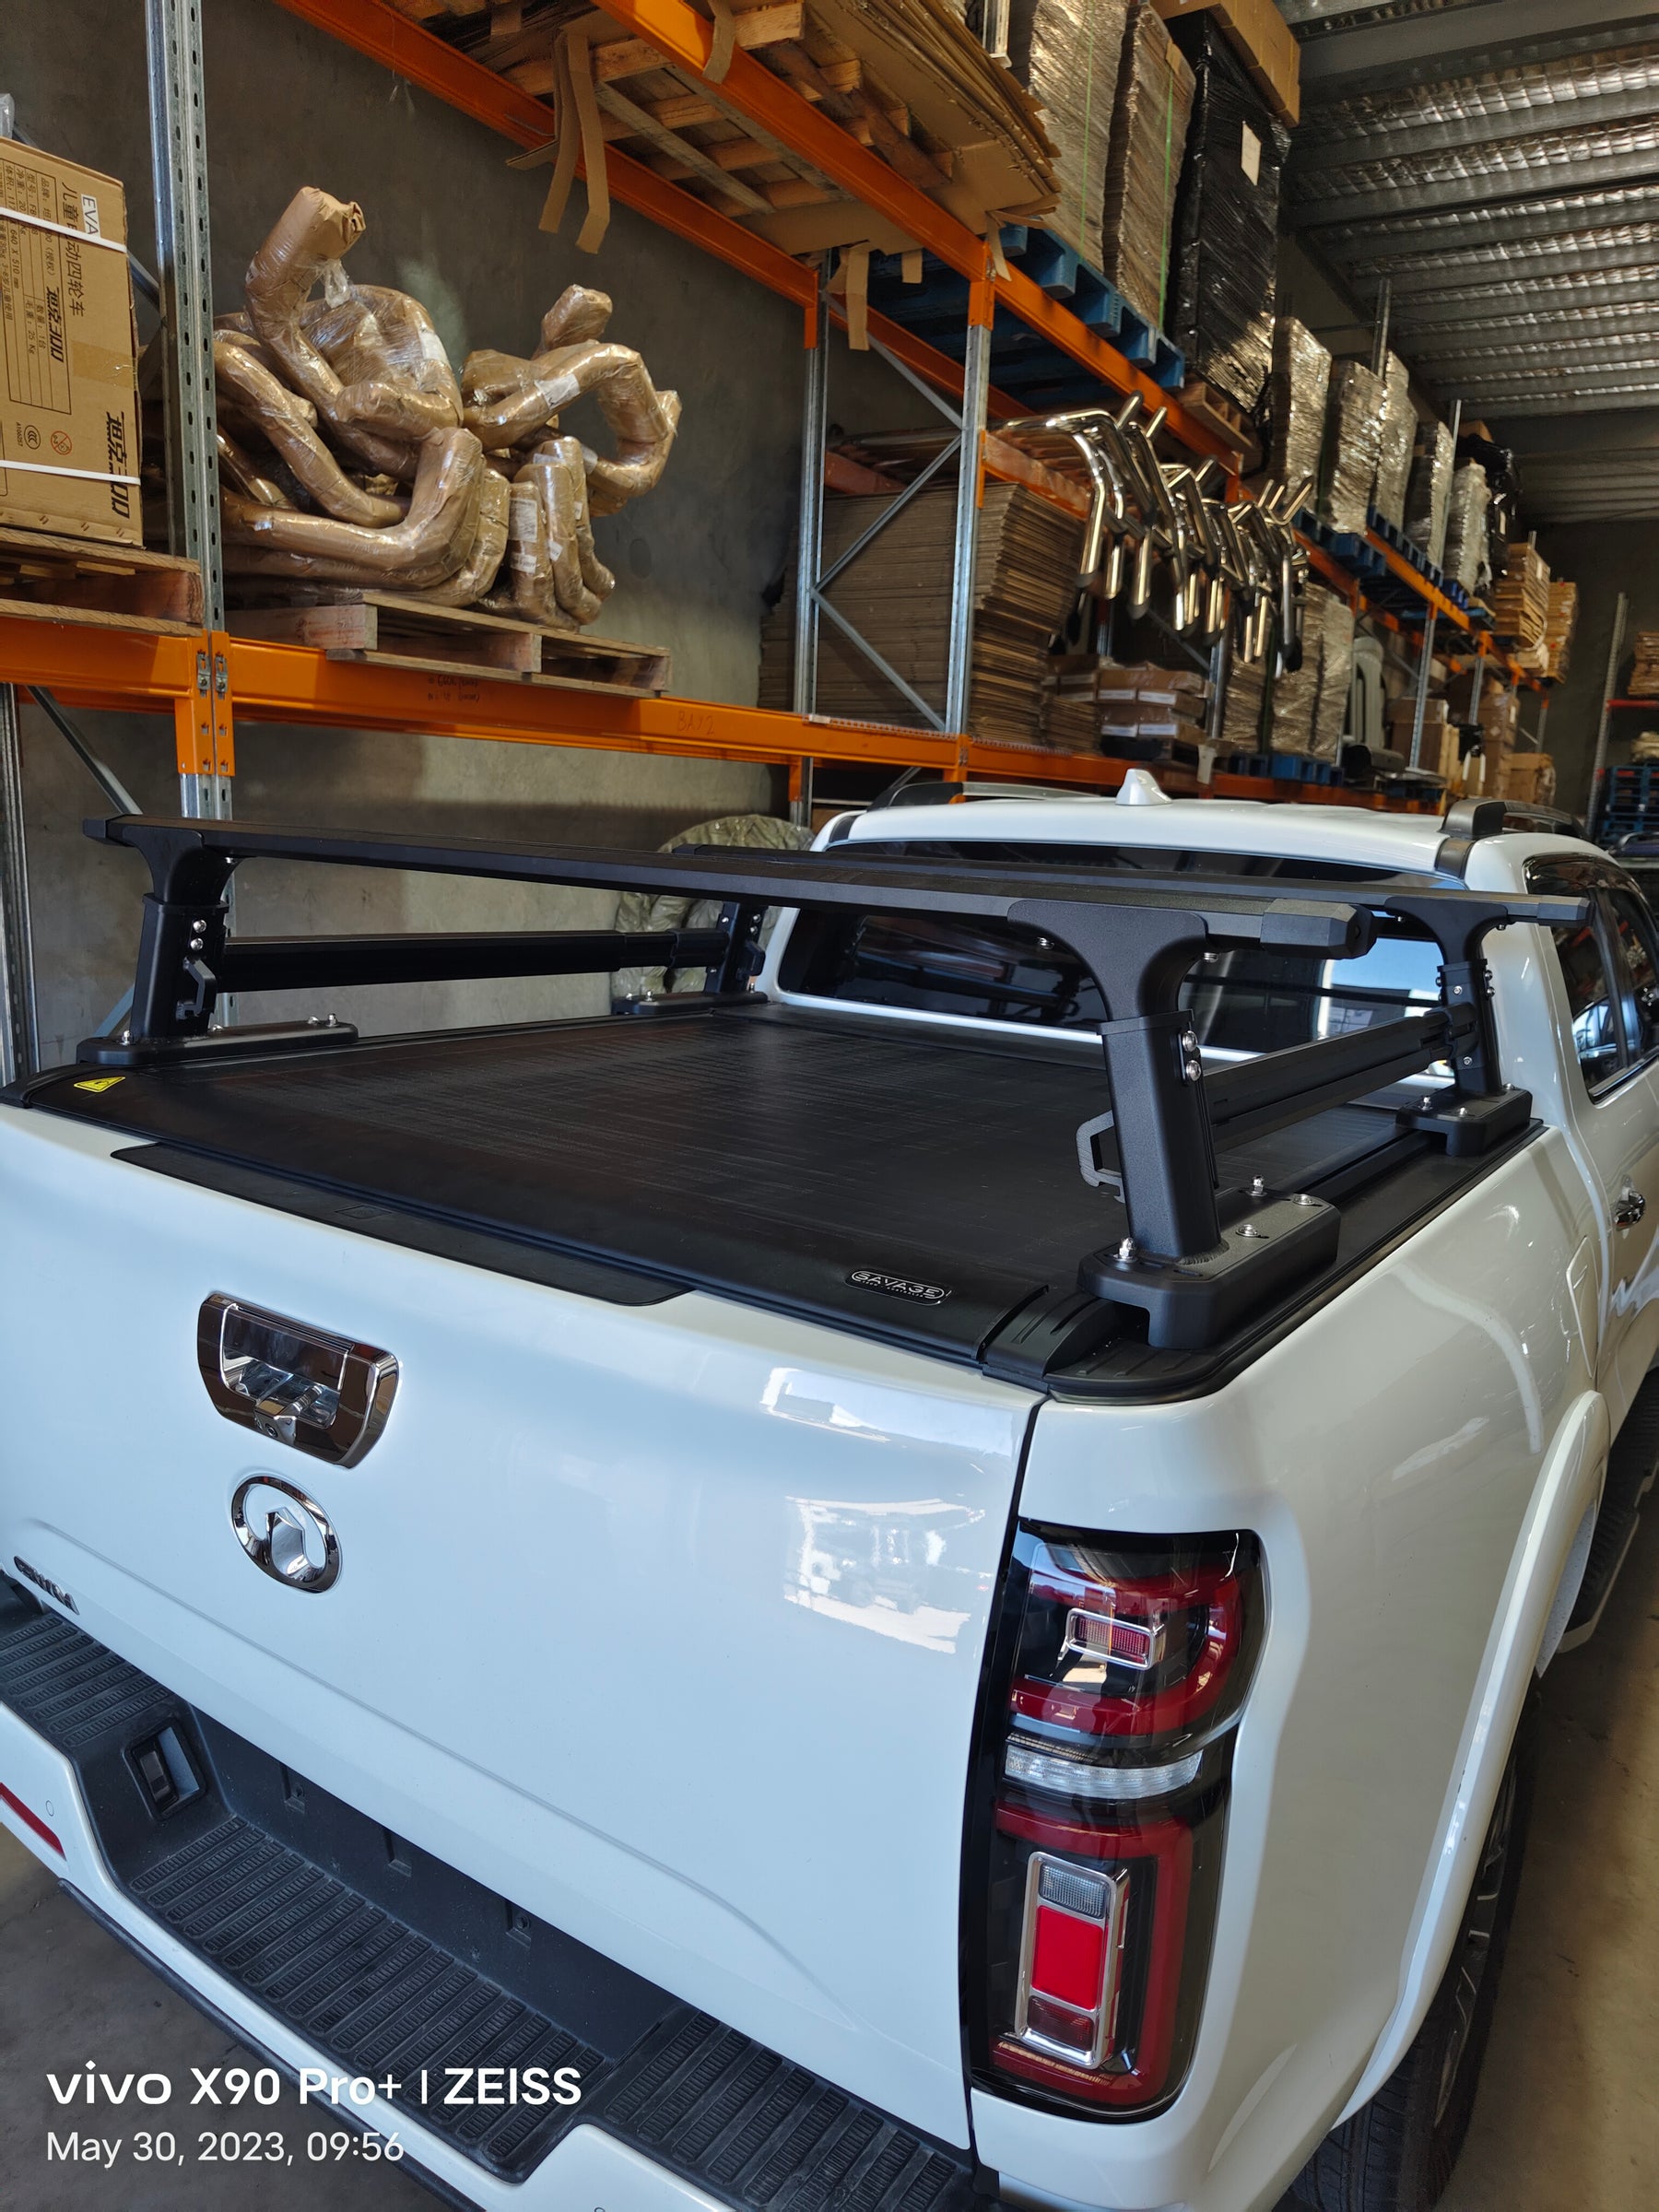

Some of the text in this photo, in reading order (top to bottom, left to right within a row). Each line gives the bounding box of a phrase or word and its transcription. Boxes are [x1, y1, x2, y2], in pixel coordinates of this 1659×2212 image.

[82, 196, 99, 234] EVA
[46, 286, 65, 363] 坦克300
[854, 1272, 940, 1299] SAVAGE
